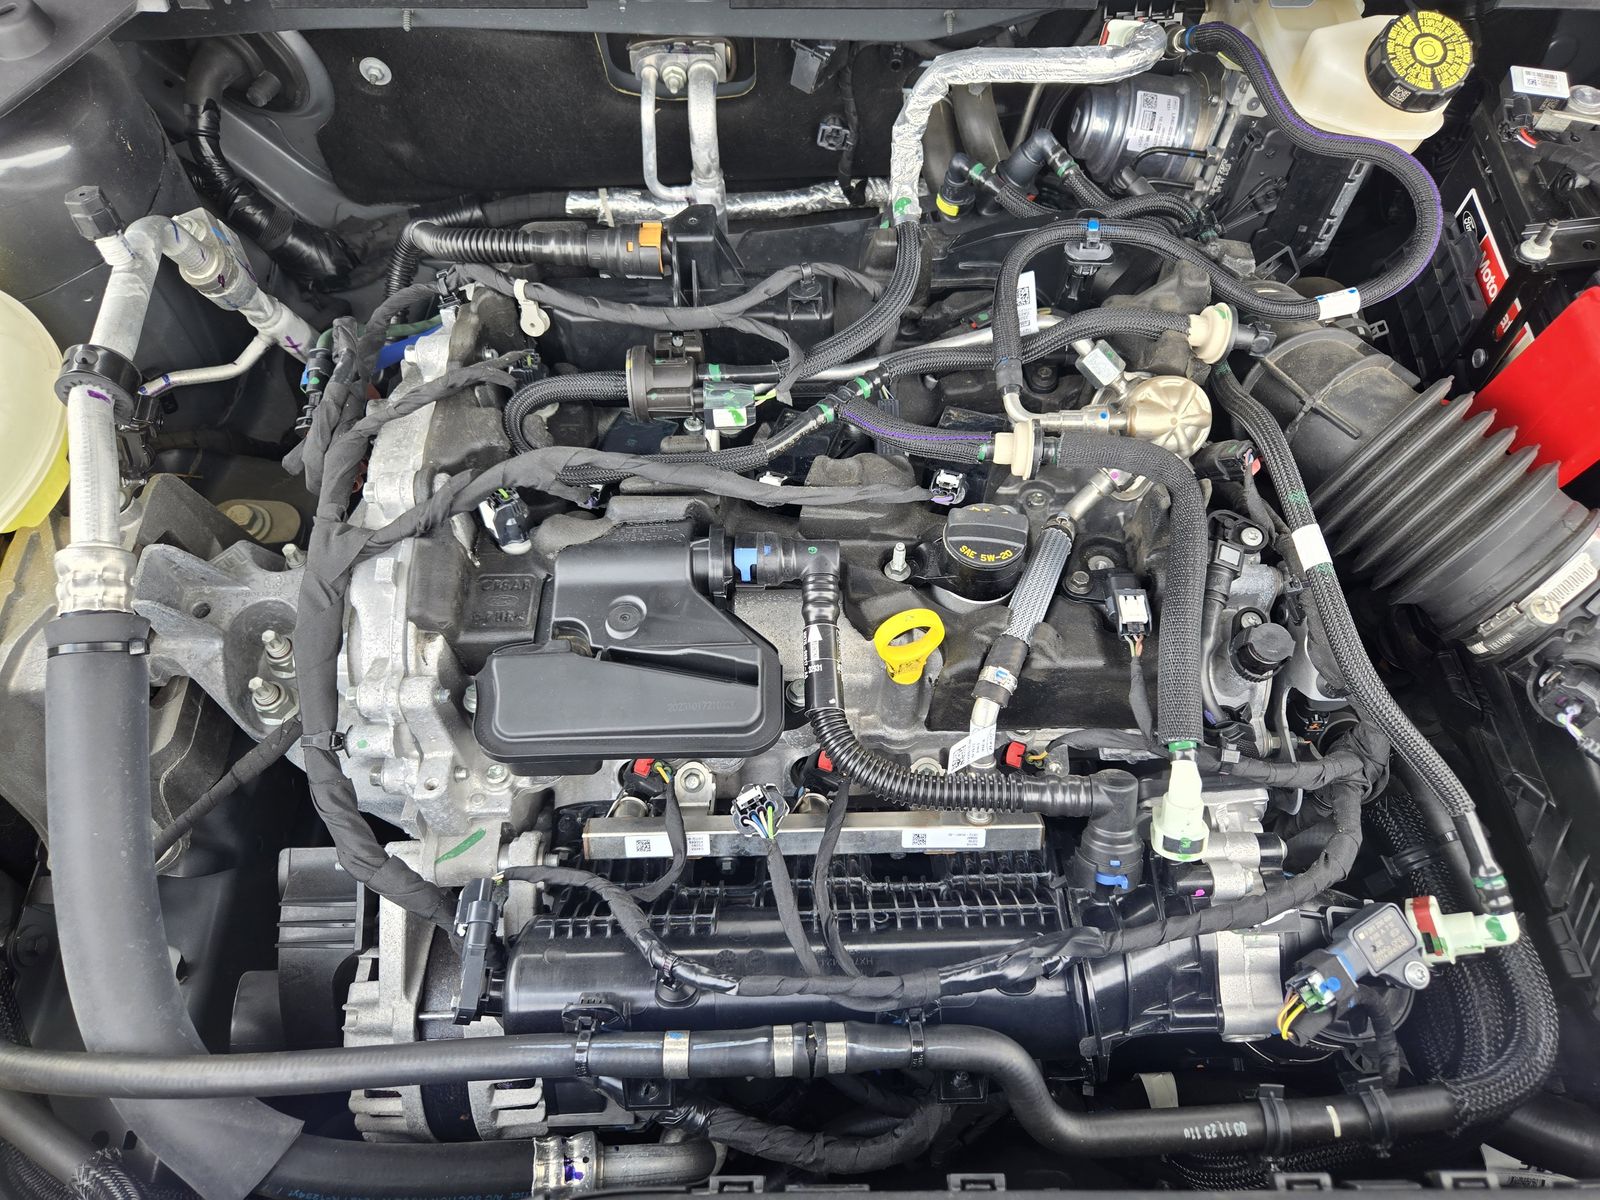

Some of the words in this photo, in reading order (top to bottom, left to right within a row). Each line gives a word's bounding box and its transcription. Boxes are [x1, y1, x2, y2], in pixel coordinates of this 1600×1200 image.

[1417, 12, 1444, 21] ATTENTION
[1386, 38, 1395, 52] FROM
[1389, 58, 1406, 77] SEALED
[1403, 74, 1433, 89] CONTAINER
[960, 545, 977, 558] SAE
[980, 550, 1013, 561] 5W-20
[1204, 1123, 1218, 1139] 23
